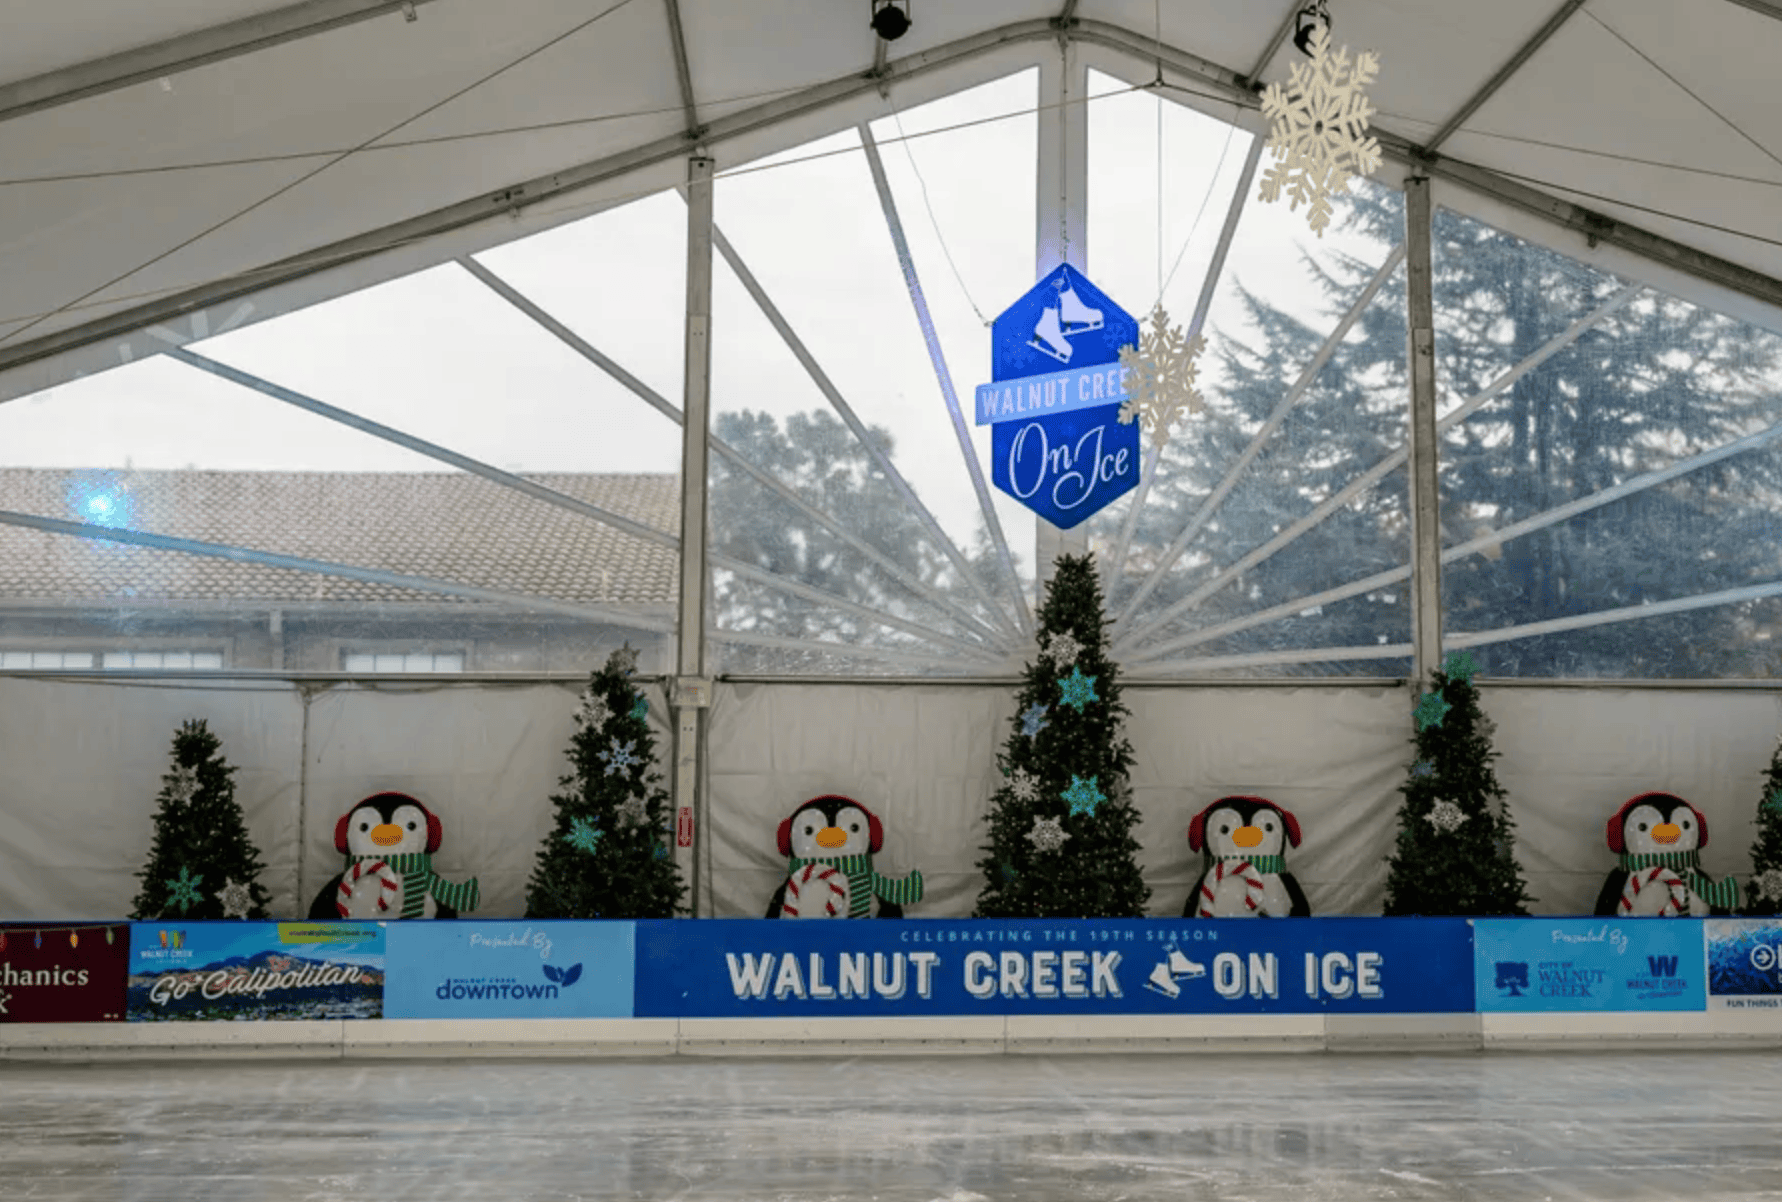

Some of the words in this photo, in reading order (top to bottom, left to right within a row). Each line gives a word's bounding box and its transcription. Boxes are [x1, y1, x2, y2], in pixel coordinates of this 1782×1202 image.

[982, 377, 1070, 417] WALNUT
[1079, 367, 1131, 402] CREE
[1009, 422, 1072, 499] On
[1052, 424, 1129, 510] Ice
[533, 931, 553, 960] By
[900, 930, 1032, 942] CELEBRATING
[1044, 930, 1078, 942] THE
[1090, 930, 1135, 942] 19TH
[1146, 930, 1219, 942] SEASON
[0, 961, 89, 987] hanics
[150, 976, 201, 1006] Go
[201, 961, 366, 1000] Calipolitan
[725, 952, 941, 1001] WALNUT
[963, 950, 1124, 999] CREEK
[1212, 951, 1279, 1000] ON
[1304, 951, 1384, 1000] ICE
[1538, 969, 1606, 984] WALNUT
[435, 978, 559, 1001] downtown
[1539, 983, 1593, 998] CREEK
[1726, 999, 1745, 1008] FUN
